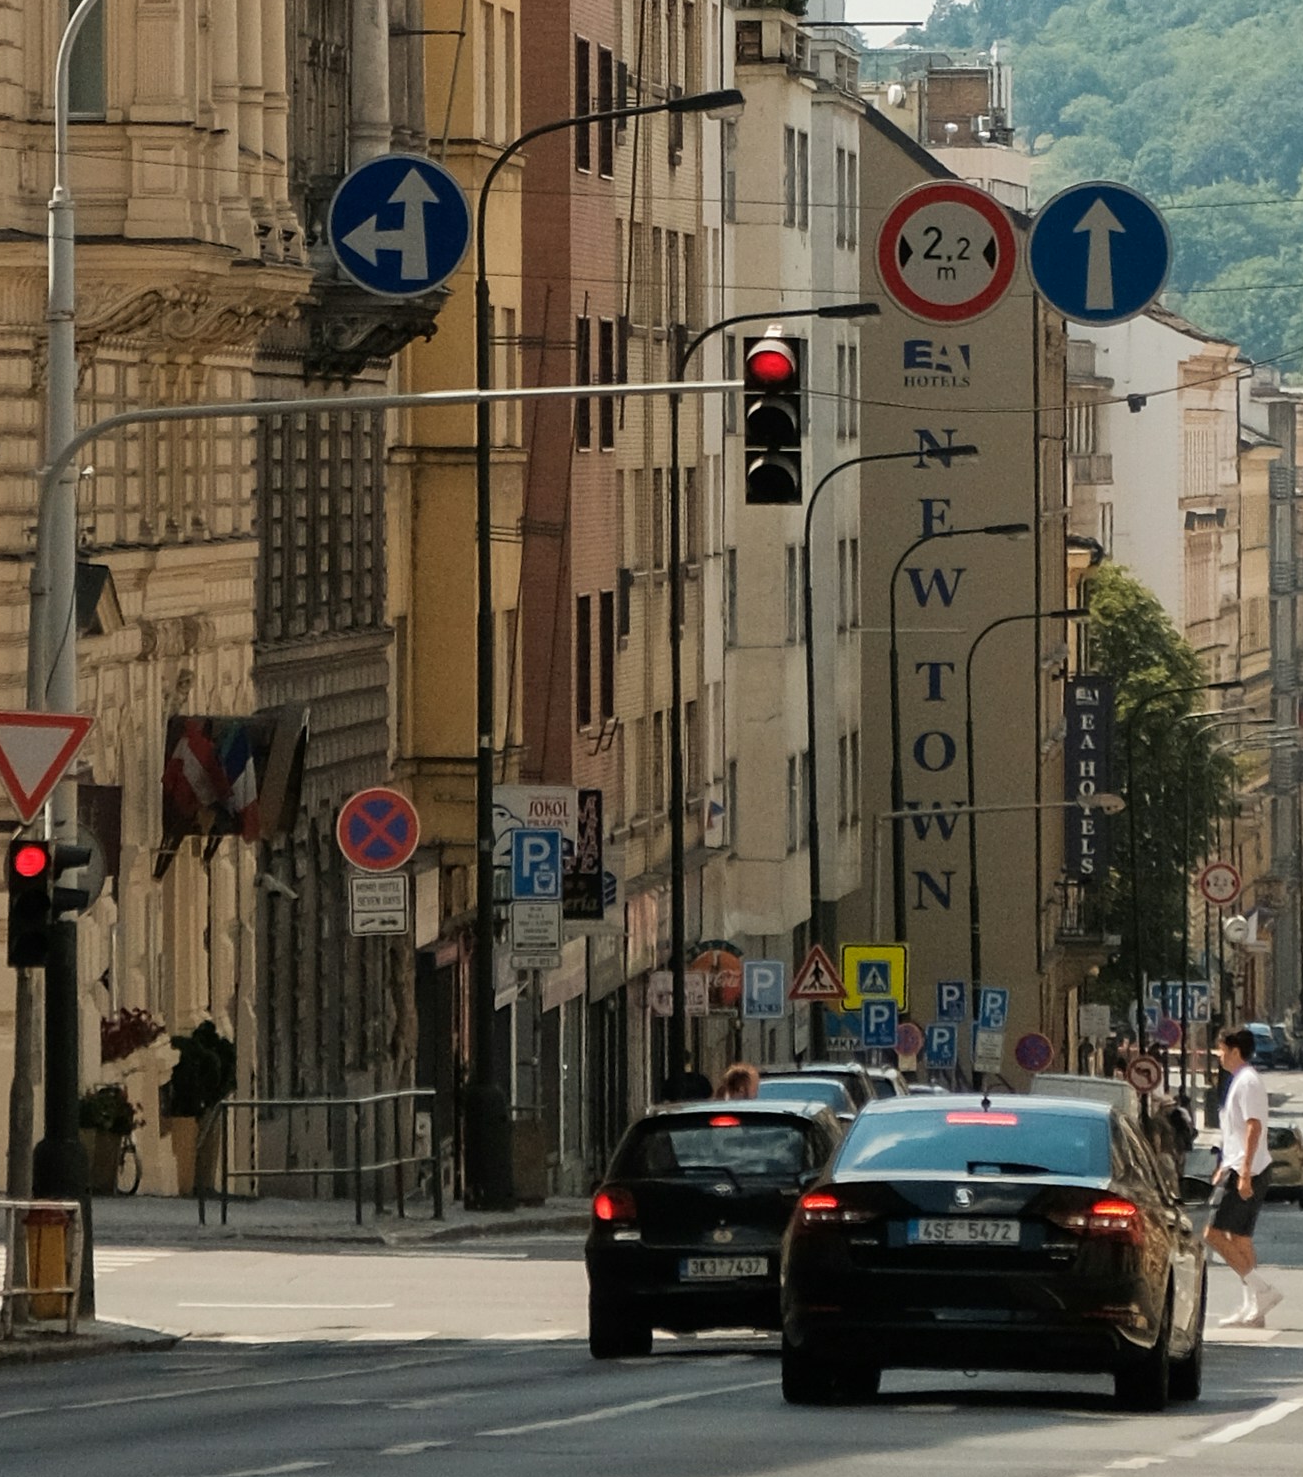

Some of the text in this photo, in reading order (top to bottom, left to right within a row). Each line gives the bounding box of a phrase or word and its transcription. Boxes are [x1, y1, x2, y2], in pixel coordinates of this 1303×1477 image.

[923, 226, 971, 262] 2,2
[937, 266, 956, 280] m
[904, 376, 970, 388] HOTELS
[904, 661, 967, 911] TOWN
[528, 800, 570, 817] SOKOL
[522, 837, 551, 877] P
[752, 968, 774, 1001] P
[942, 985, 959, 1011] P
[985, 993, 1002, 1017] P
[869, 1005, 890, 1033] P
[932, 1028, 950, 1052] P
[923, 1223, 1012, 1240] 4SE 5472
